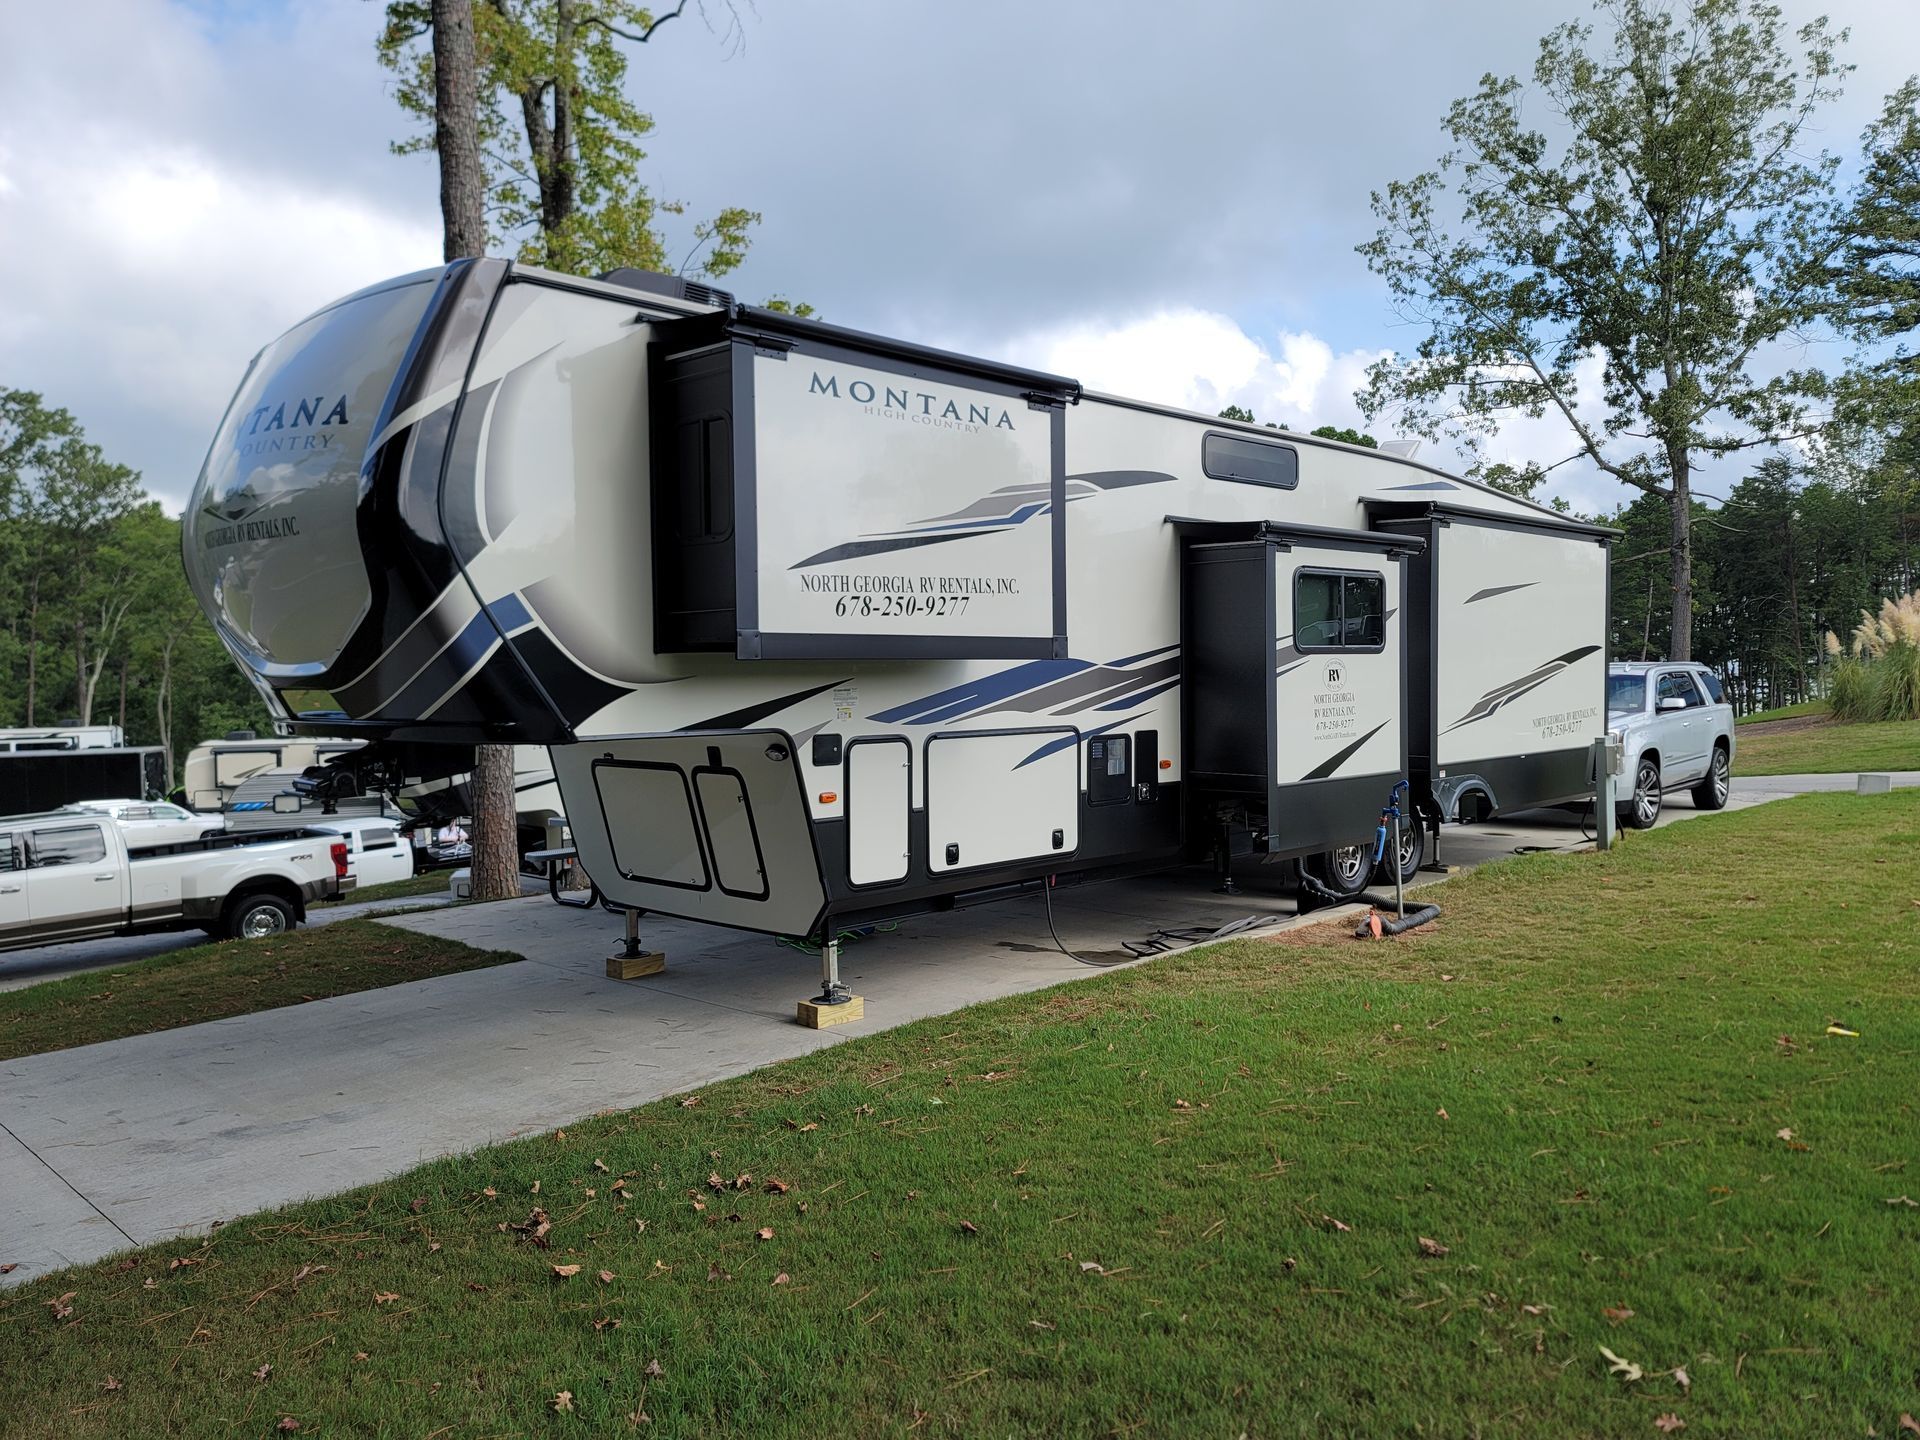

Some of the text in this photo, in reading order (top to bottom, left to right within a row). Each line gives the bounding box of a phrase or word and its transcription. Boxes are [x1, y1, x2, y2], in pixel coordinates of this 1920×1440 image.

[809, 371, 1016, 431] MONTANA
[242, 394, 349, 436] TANA
[864, 405, 981, 434] HIGH COUNTRY
[238, 434, 335, 458] OUNTRY
[282, 516, 300, 537] INC.
[801, 574, 1020, 598] NORTH GEORGIA RV RENTALS, INC.
[835, 595, 970, 617] 678-250-9277
[1328, 668, 1342, 682] RV
[1313, 692, 1355, 704] NORTH GEORGIA
